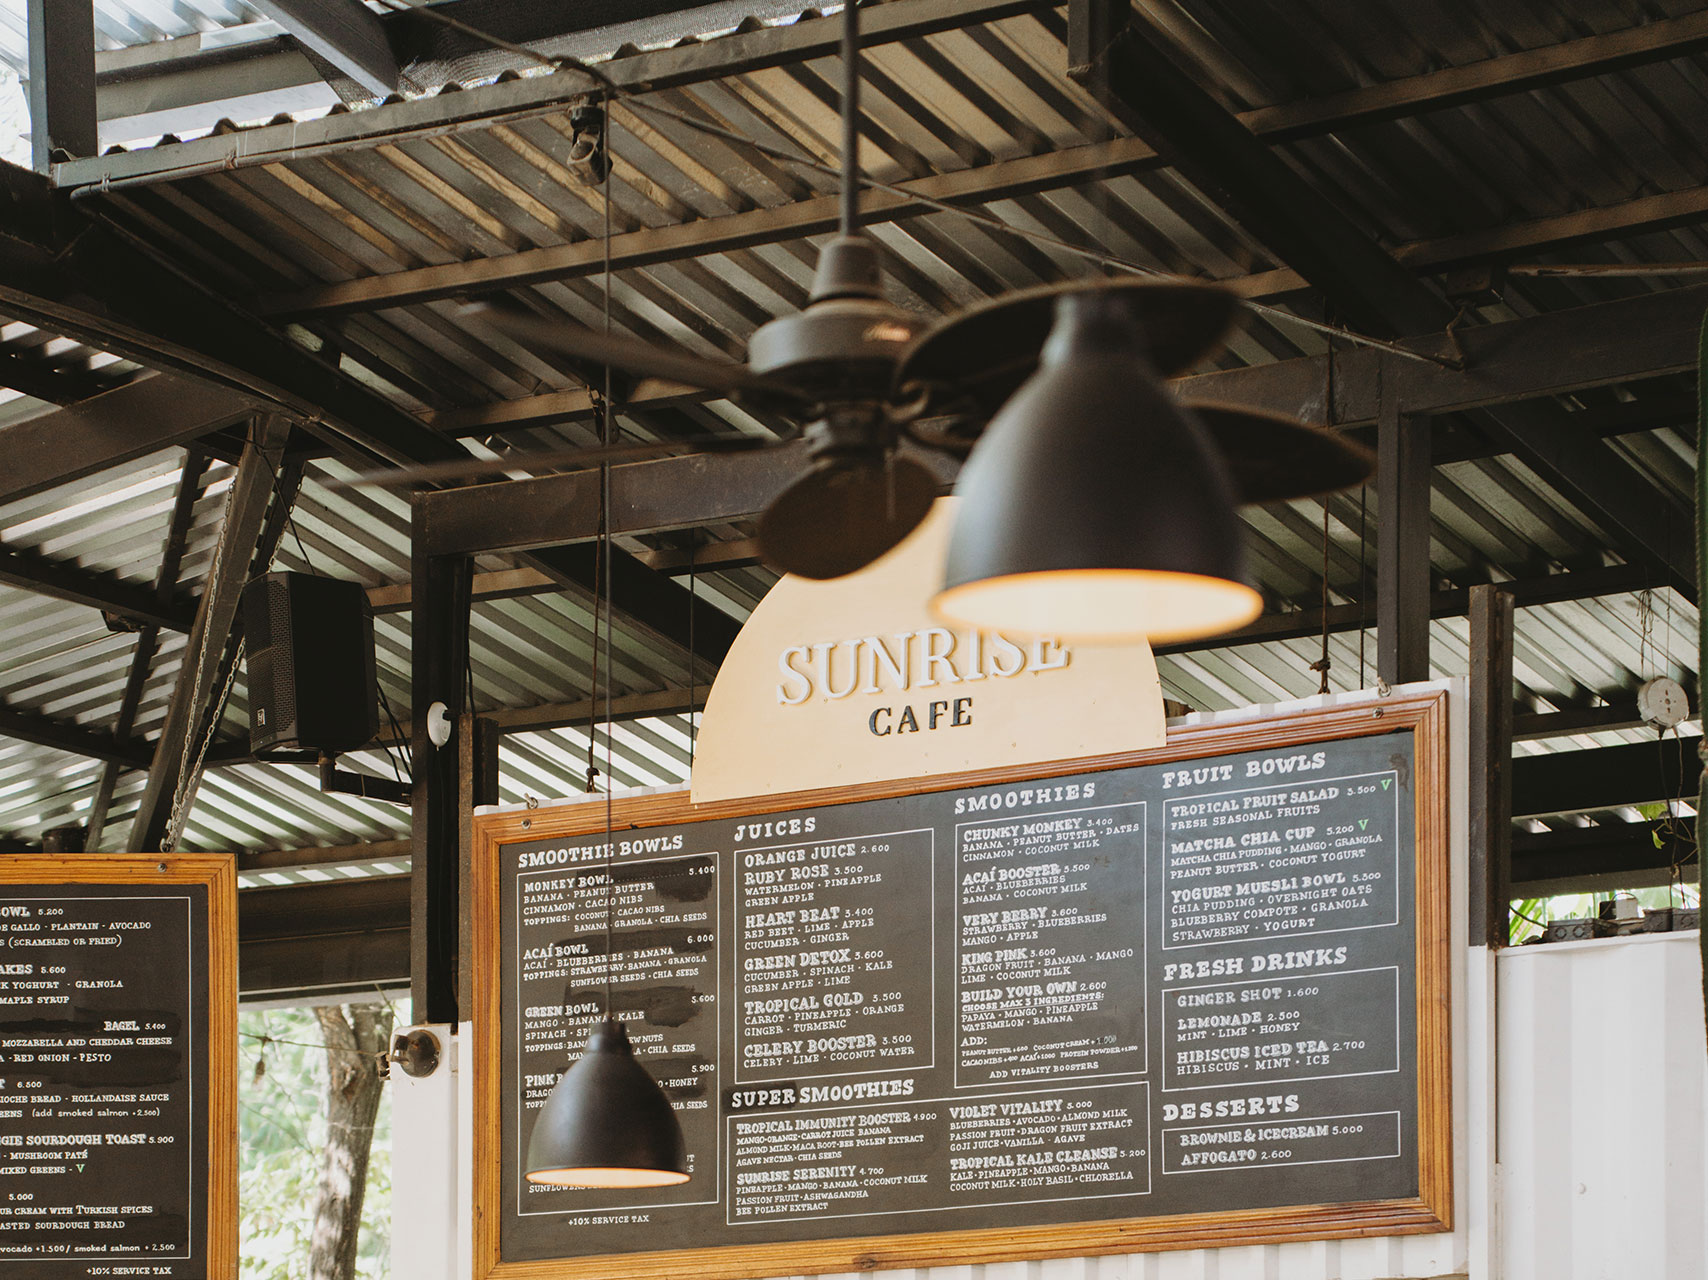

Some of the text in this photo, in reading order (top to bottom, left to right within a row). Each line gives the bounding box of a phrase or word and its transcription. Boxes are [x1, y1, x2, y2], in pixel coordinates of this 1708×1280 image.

[776, 625, 1070, 706] SUNRISE
[869, 697, 973, 737] CAFE
[1162, 752, 1326, 789] FRUIT BOWLS
[954, 783, 1095, 814] SMOOTHIES
[1171, 787, 1339, 817] TROPICAL FRUIT SALAD
[1171, 805, 1320, 830] FRESH SEASONAL FRUITS
[734, 817, 816, 841] JUICES
[964, 818, 1083, 842] CHUNKY MONKEY
[1171, 825, 1354, 854] MATCHA CHIA CUP 5.200
[518, 835, 683, 868] SMOOTHIE BOWLS
[745, 844, 889, 867] ORANGE JUICE 2.600
[963, 840, 1100, 862] CINNAMON COCONUT MILK
[525, 866, 715, 893] MONKEY BOWL 5.400
[745, 864, 829, 885] RUBY ROSE
[999, 863, 1061, 881] BOOSTER
[1171, 872, 1346, 903] YOGURT MUESLI BOWL
[51, 923, 99, 931] PLANTAIN
[109, 922, 151, 930] AVOCADO
[574, 923, 607, 932] BANANA
[615, 918, 653, 928] GRANOLA
[683, 913, 707, 921] SEEDS
[745, 907, 840, 928] HEART BEAT
[962, 907, 1048, 926] VERY BERRY
[556, 944, 589, 957] BOWL
[688, 934, 714, 943] 6.000
[745, 949, 850, 971] GREEN DETOX
[961, 948, 1028, 966] KING PINK
[1163, 947, 1347, 982] FRESH DRINKS
[961, 981, 1107, 1003] BUILD YOUR OWN 2.600
[1177, 987, 1319, 1007] GINGER SHOT 1.600
[525, 995, 715, 1017] GREEN BOWL 5.600
[745, 992, 864, 1015] TROPICAL GOLD
[745, 1004, 904, 1025] CARROT PINEAPPLE ORANGE
[961, 1002, 1098, 1022] PAPAYA MANGO PINEAPPLE
[104, 1021, 140, 1031] BAGEL
[1177, 1012, 1262, 1030] LEMONADE
[744, 1034, 877, 1058] CELERY BOOSTER
[1177, 1040, 1365, 1064] HIBISCUS ICED TEA 2.700
[692, 1064, 715, 1072] 5.900
[1177, 1055, 1330, 1075] HIBISCUS MINT ICE
[525, 1074, 554, 1086] PINK
[31, 1095, 62, 1103] BREAD
[72, 1094, 136, 1102] HOLLANDAISE
[732, 1079, 914, 1108] SUPER SMOOTHIES
[949, 1099, 1063, 1119] VIOLET VITALITY
[1163, 1095, 1300, 1121] DESSERTS
[736, 1112, 911, 1135] TROPICAL IMMUNITY BOOSTER
[26, 1134, 146, 1145] SOURDOUGH TOAST
[1180, 1125, 1363, 1146] BROWNIE & ICECREAM 5.000
[951, 1147, 1118, 1170] TROPICAL KALE CLEANSE
[1181, 1149, 1292, 1166] AFFOGATO 2.600
[737, 1166, 884, 1185] SUNRISE SERENITY 4.700
[592, 1216, 629, 1224] SERVICE
